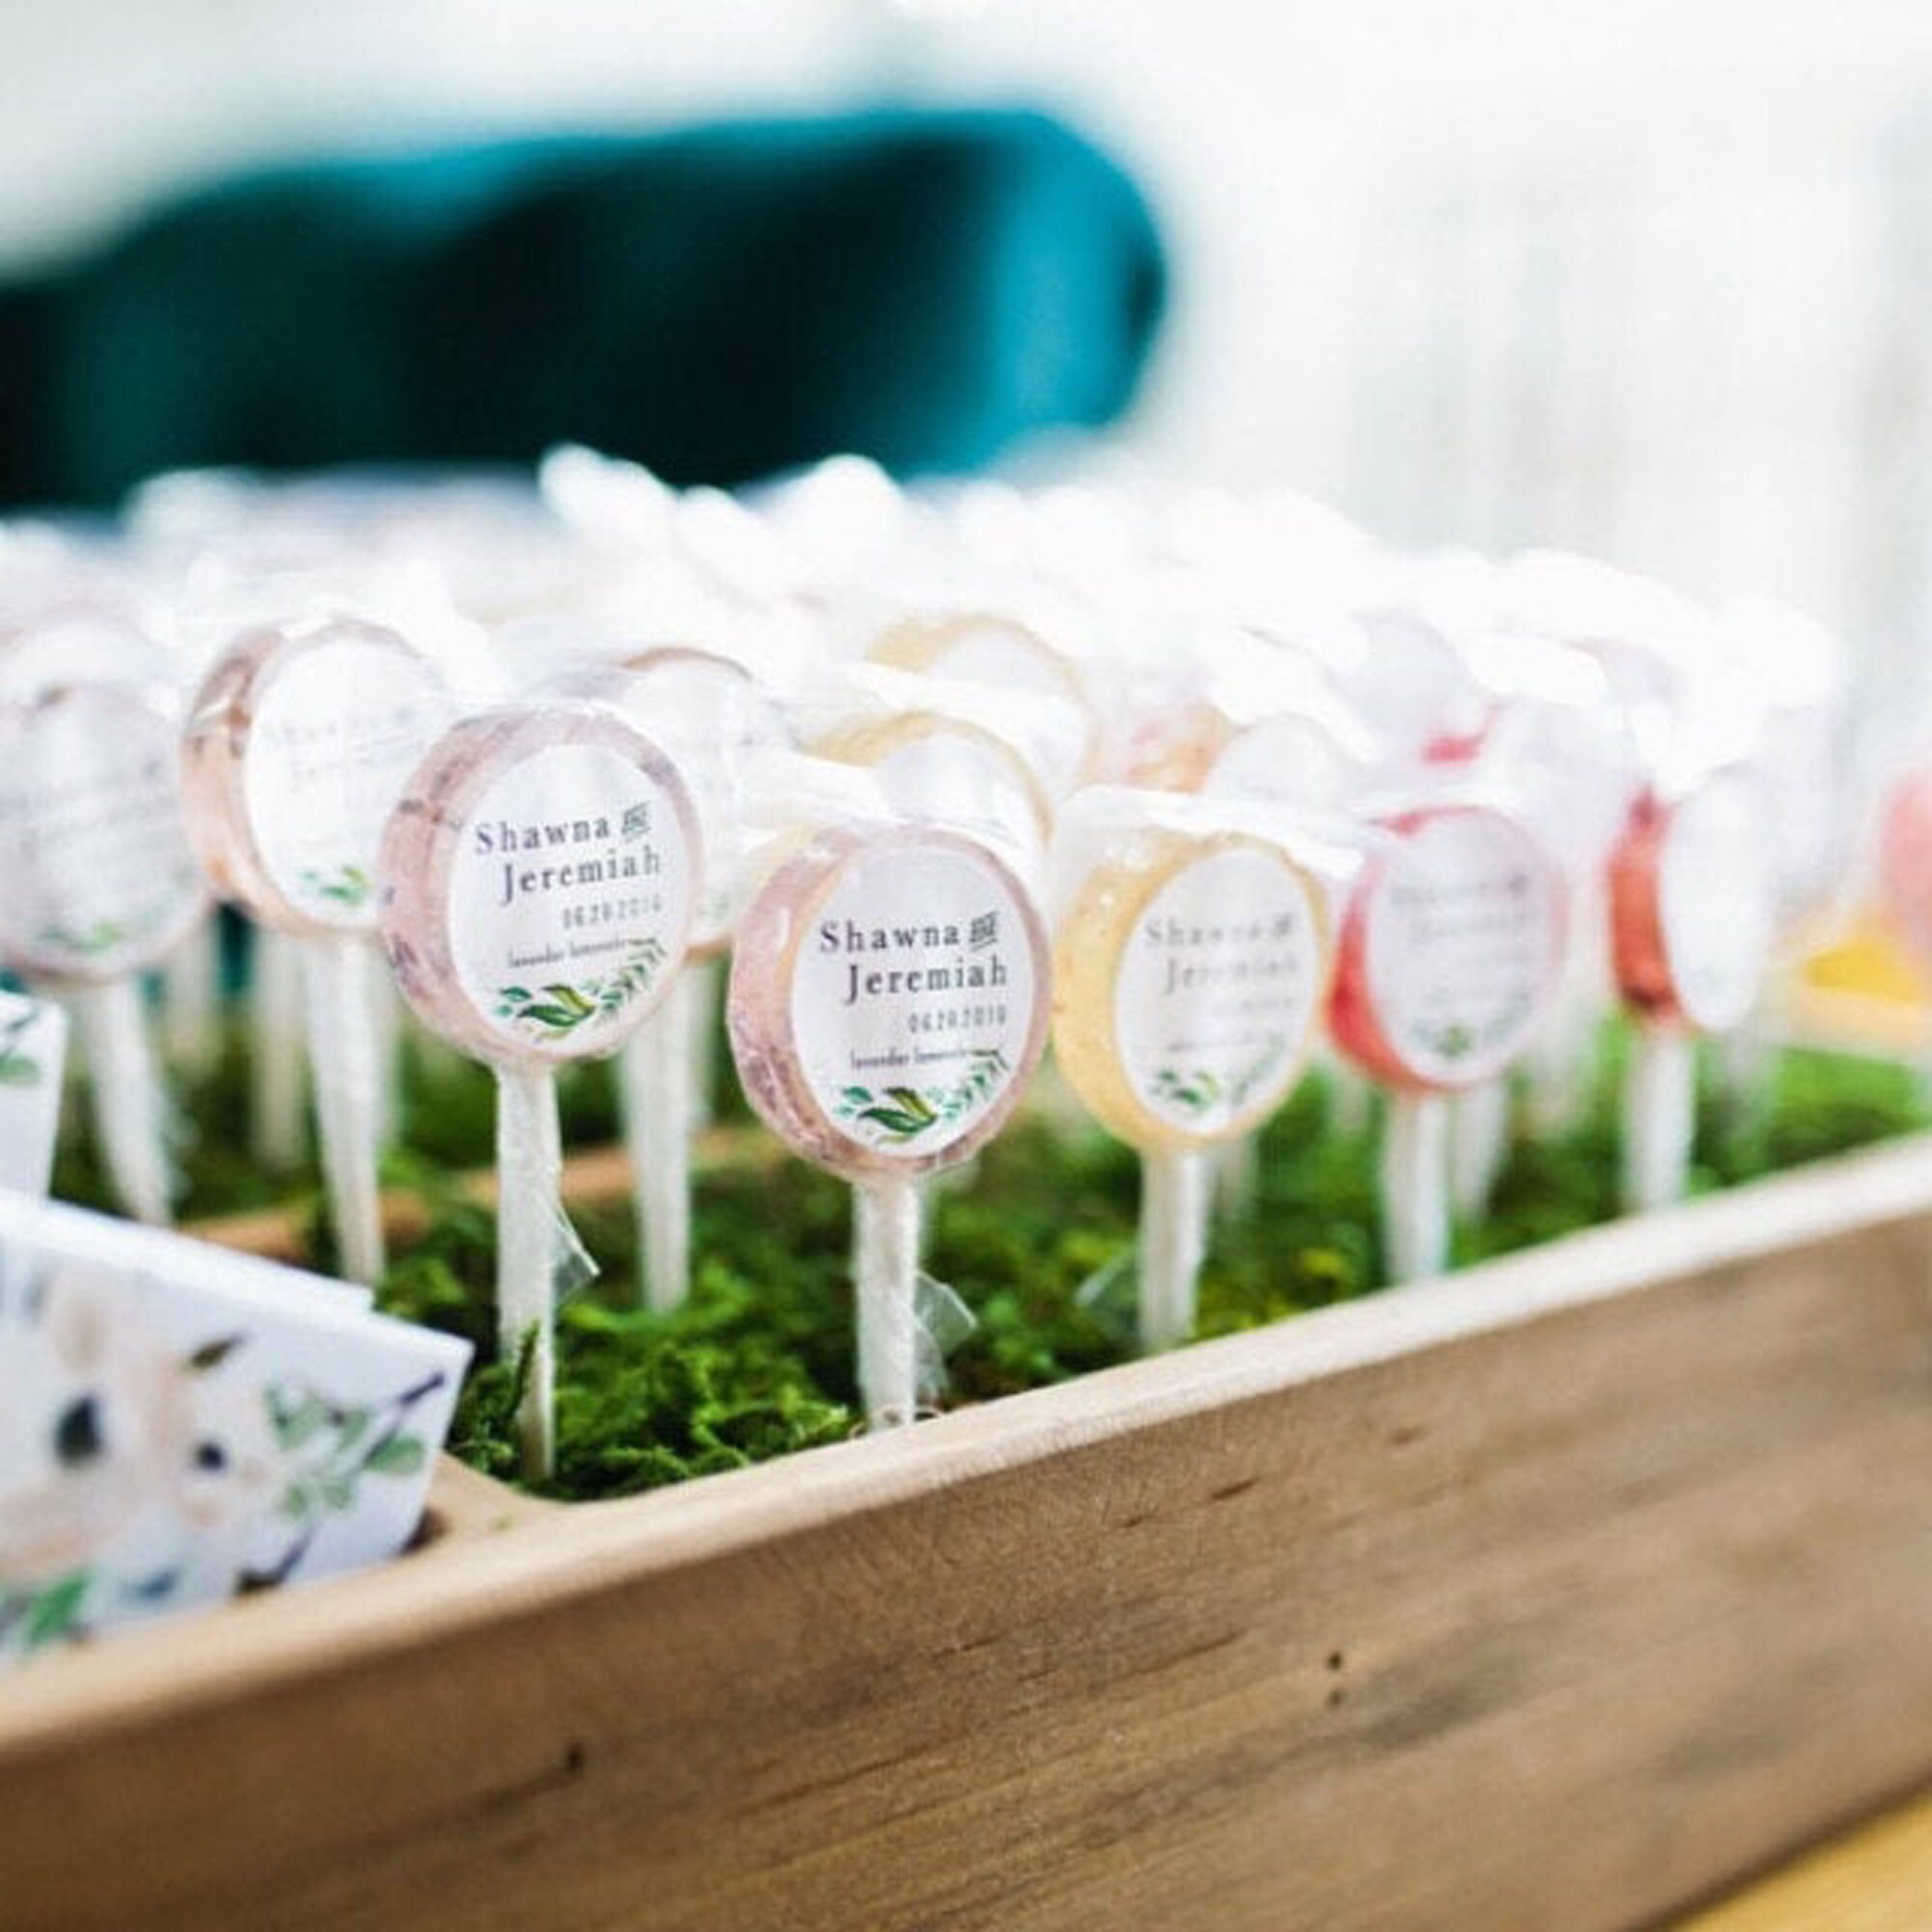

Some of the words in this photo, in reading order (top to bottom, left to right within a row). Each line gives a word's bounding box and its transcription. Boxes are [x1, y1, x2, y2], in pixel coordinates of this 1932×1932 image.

[474, 817, 610, 854] Shawna
[500, 843, 661, 906] Jeremiah
[819, 918, 960, 953] Shawna
[844, 952, 1008, 1006] Jeremiah
